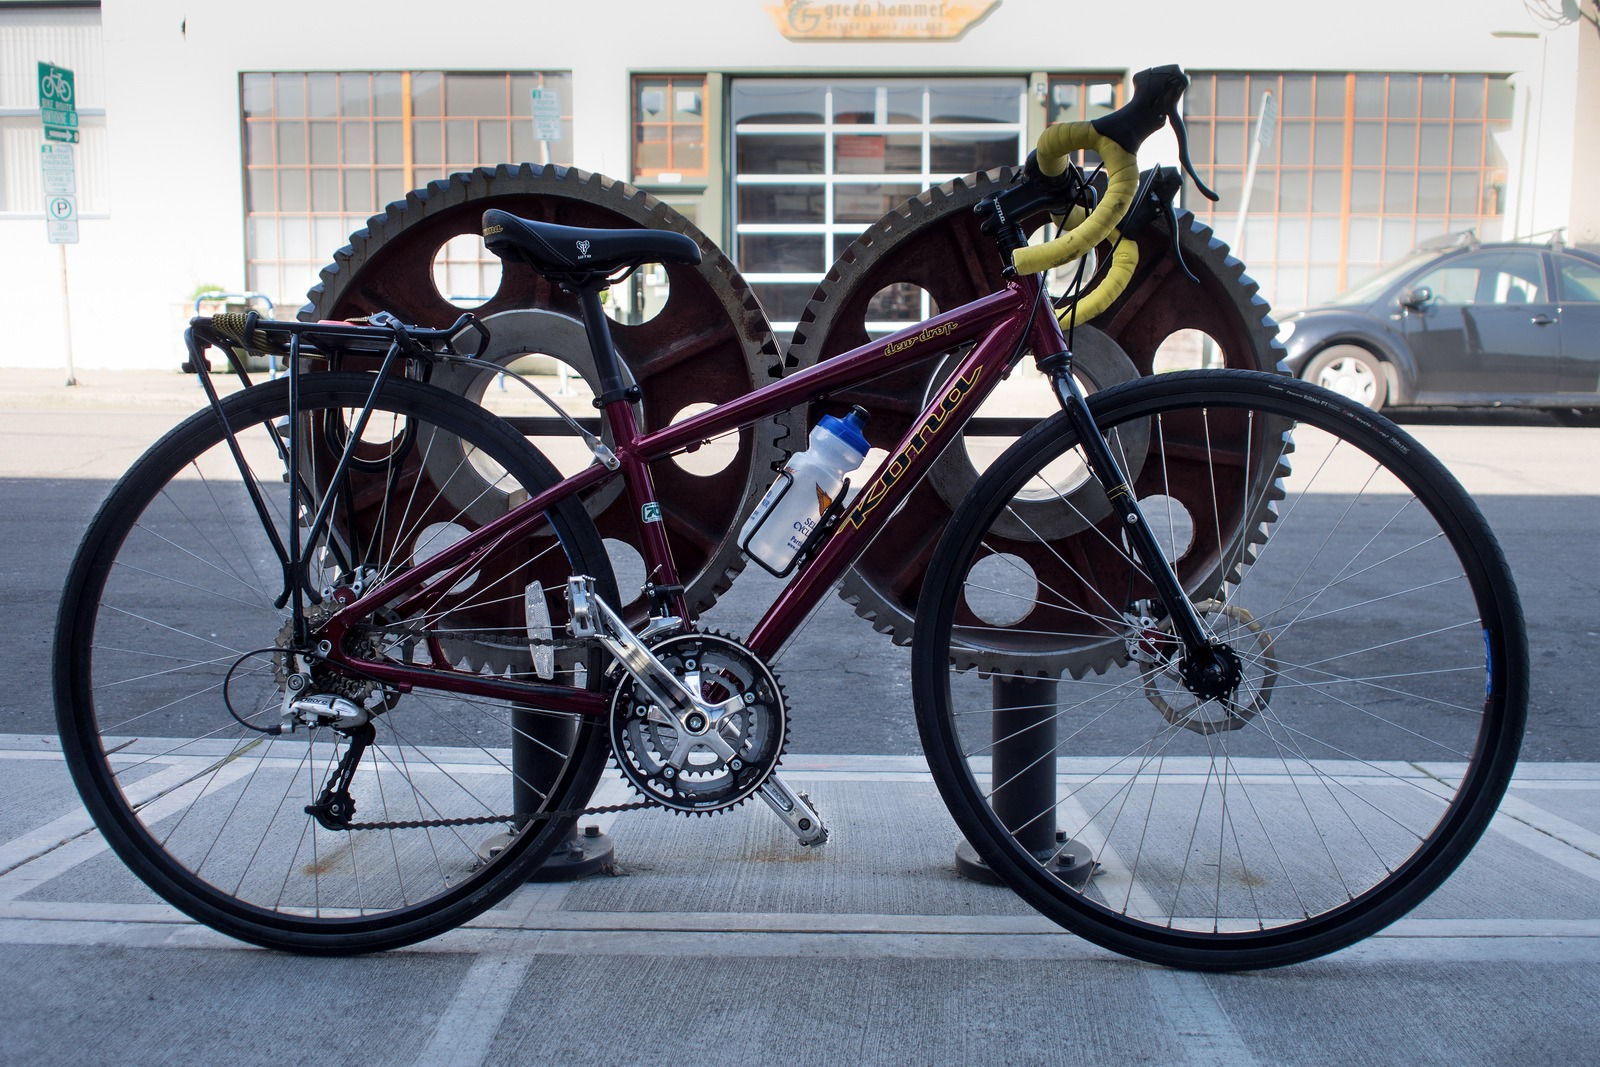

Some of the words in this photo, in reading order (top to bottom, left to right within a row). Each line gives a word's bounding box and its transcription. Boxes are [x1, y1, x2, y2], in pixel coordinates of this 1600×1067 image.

[825, 3, 872, 18] green
[877, 1, 946, 17] hammer
[57, 202, 68, 215] P
[793, 521, 810, 537] CYCL
